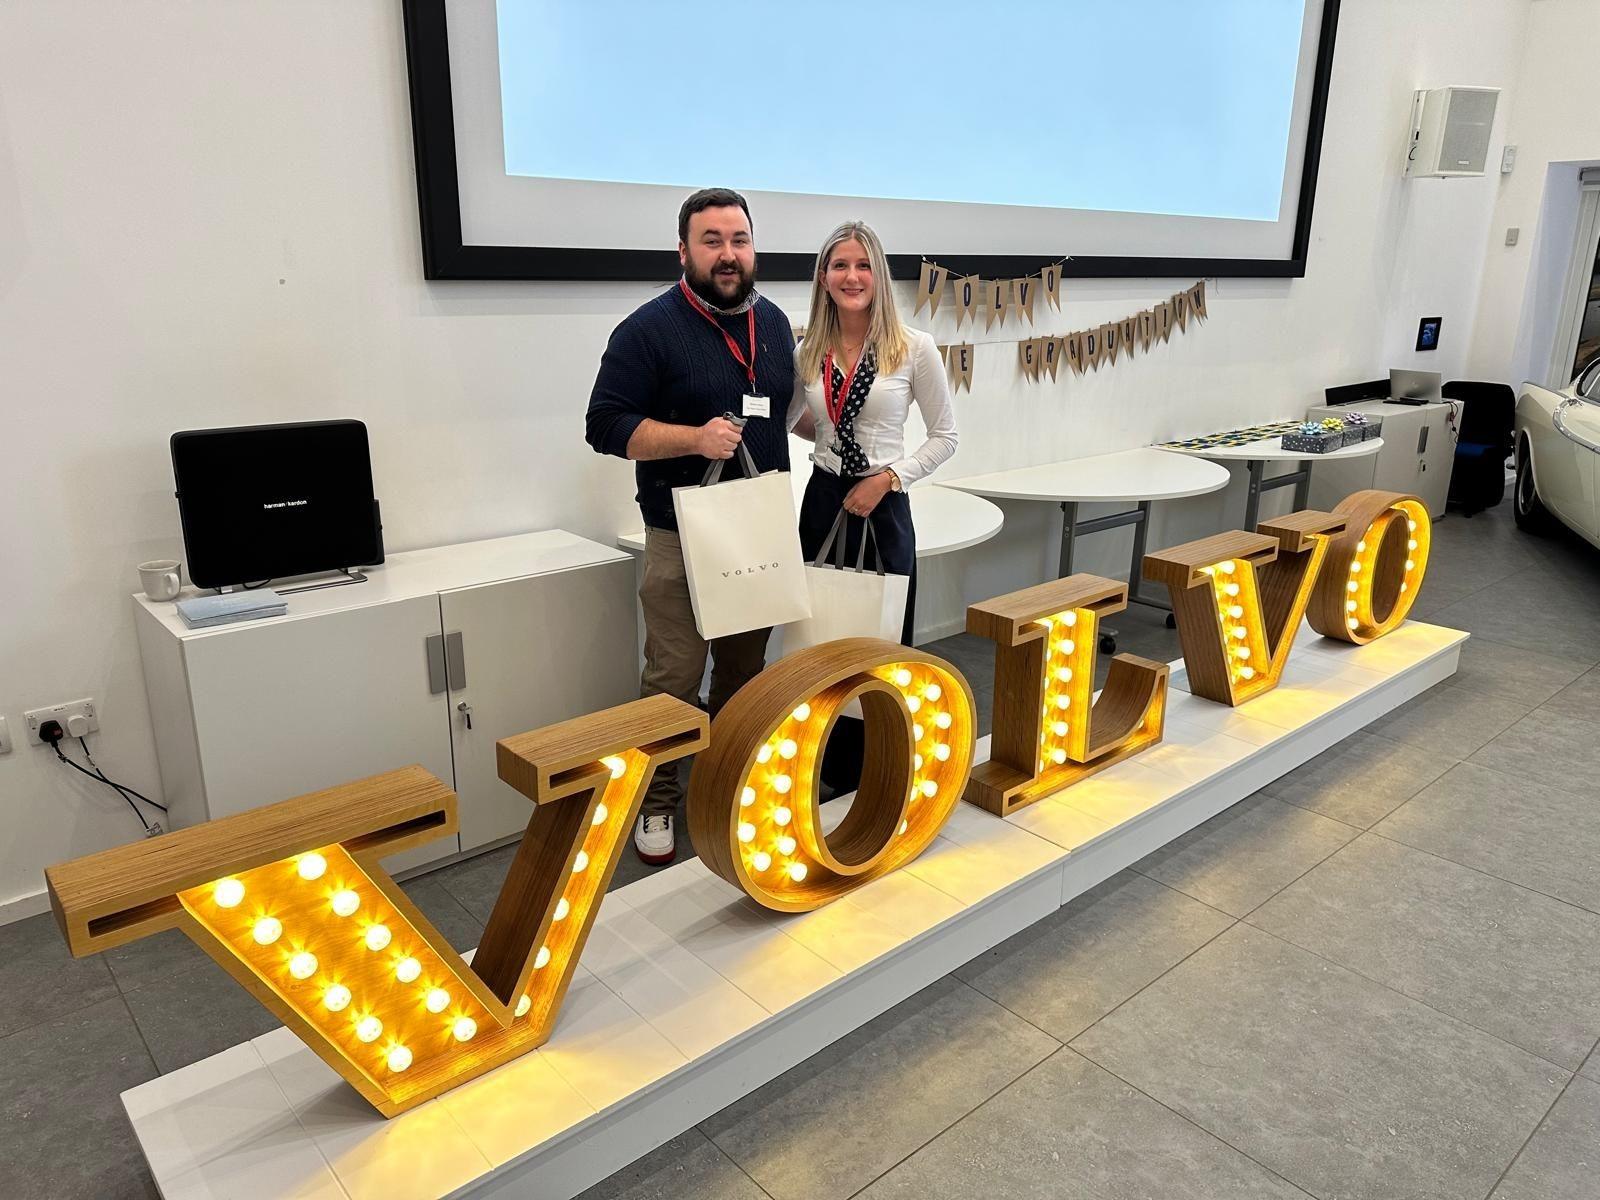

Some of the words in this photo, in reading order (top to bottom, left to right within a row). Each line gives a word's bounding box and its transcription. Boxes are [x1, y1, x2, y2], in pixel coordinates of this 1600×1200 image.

[928, 268, 1054, 309] VOLVO
[1025, 289, 1202, 364] GRADUATION
[721, 562, 779, 578] VOLVO
[45, 489, 1432, 1118] VOLVO
